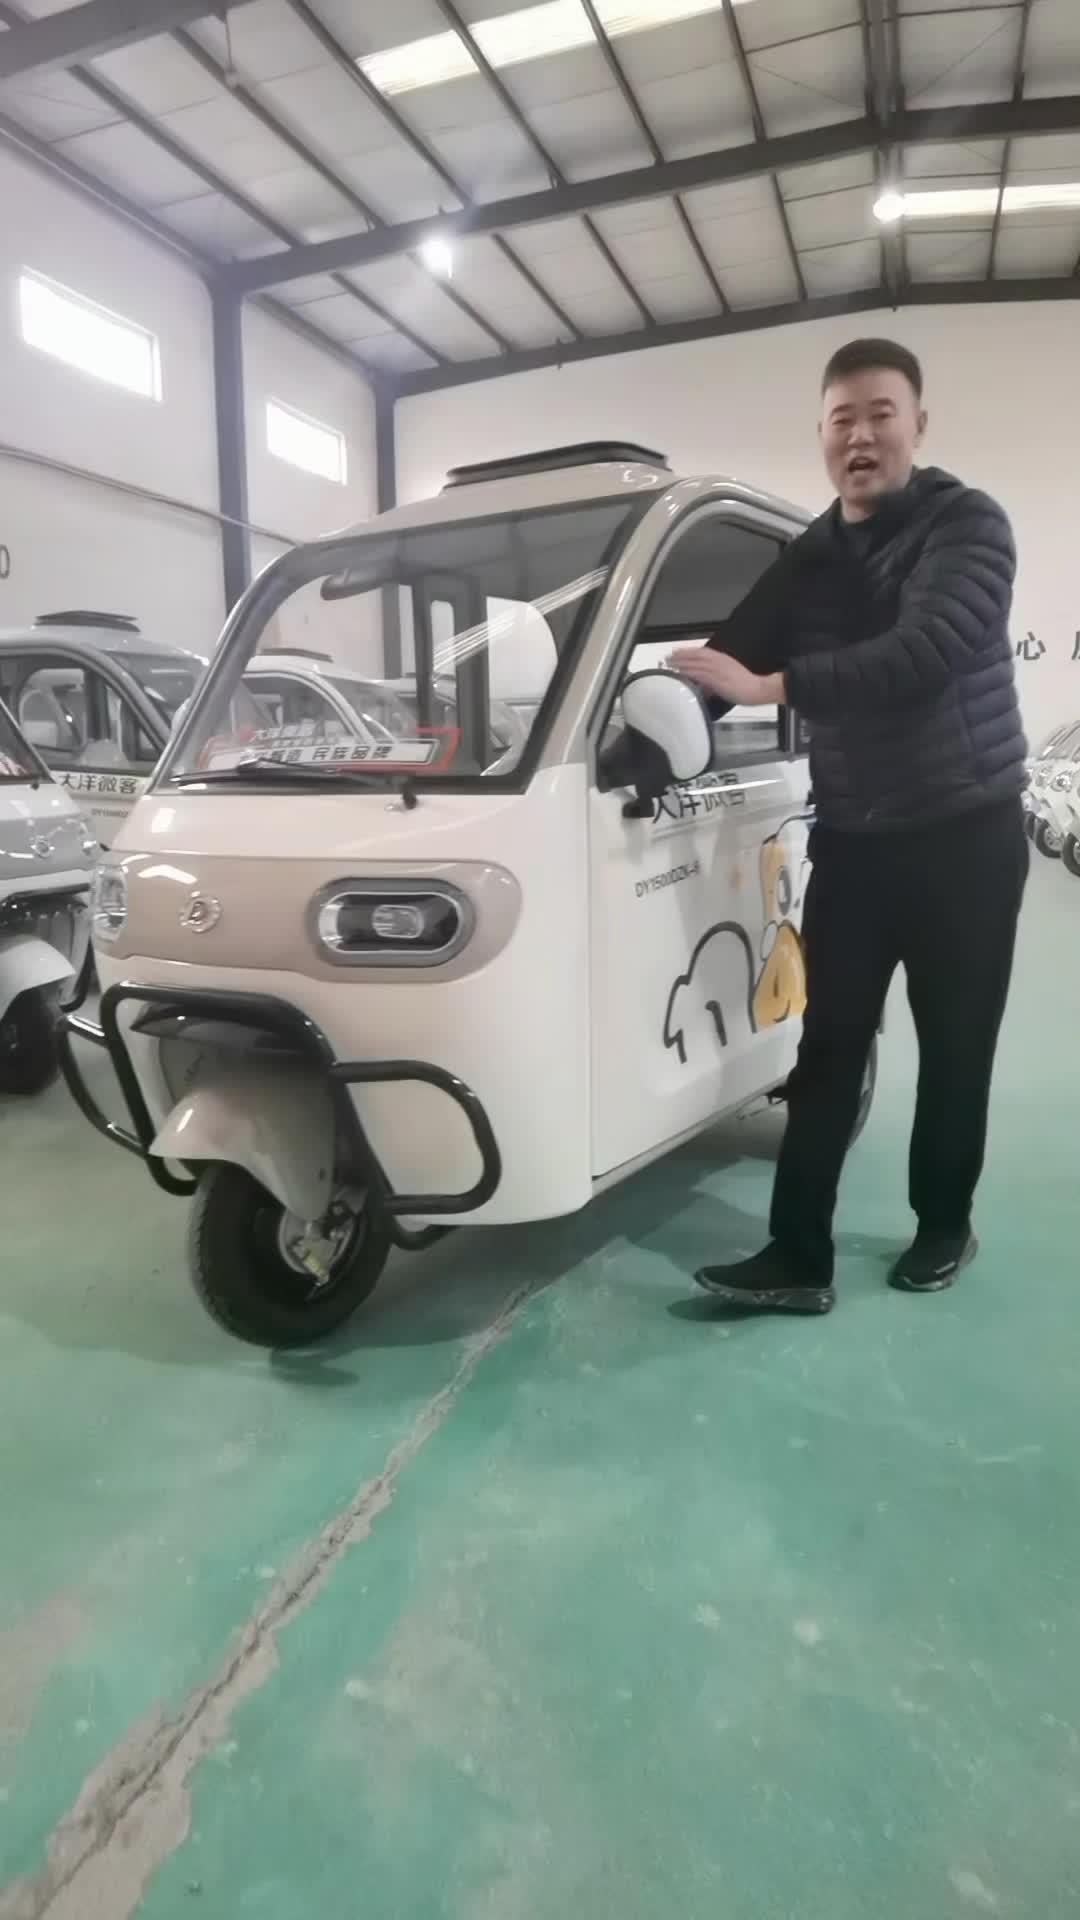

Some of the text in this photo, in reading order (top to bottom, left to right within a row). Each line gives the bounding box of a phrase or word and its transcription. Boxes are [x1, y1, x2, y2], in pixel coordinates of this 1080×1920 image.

[1016, 631, 1046, 660] 心
[60, 774, 138, 794] 大洋微客
